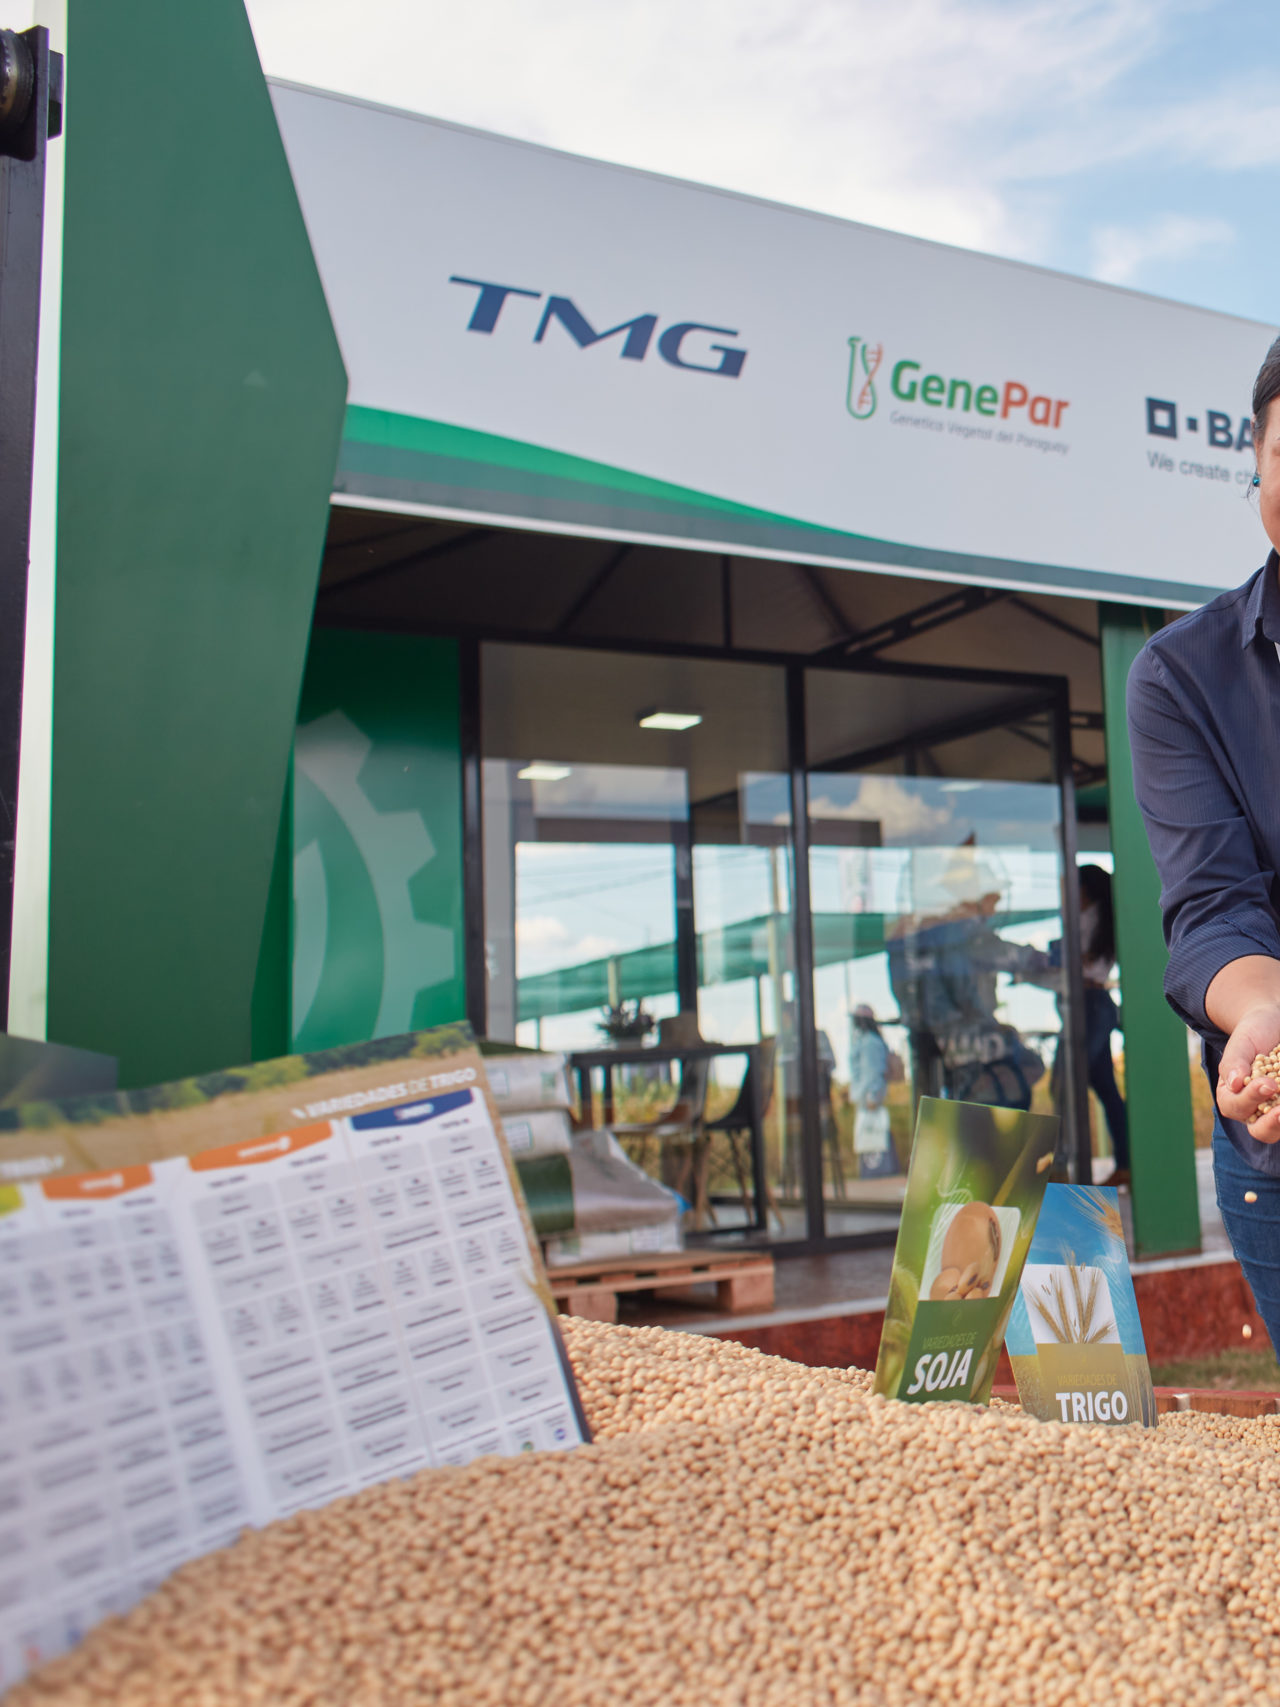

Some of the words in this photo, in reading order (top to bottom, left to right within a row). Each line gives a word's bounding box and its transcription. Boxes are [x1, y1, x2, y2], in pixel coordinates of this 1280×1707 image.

[449, 275, 748, 378] TMG
[890, 359, 1069, 429] GenePar
[1206, 408, 1256, 452] BA
[1147, 451, 1175, 472] We
[1179, 460, 1231, 482] create
[429, 1067, 477, 1090] TRIGO
[906, 1348, 974, 1396] SOJA
[1055, 1390, 1129, 1424] TRIGO
